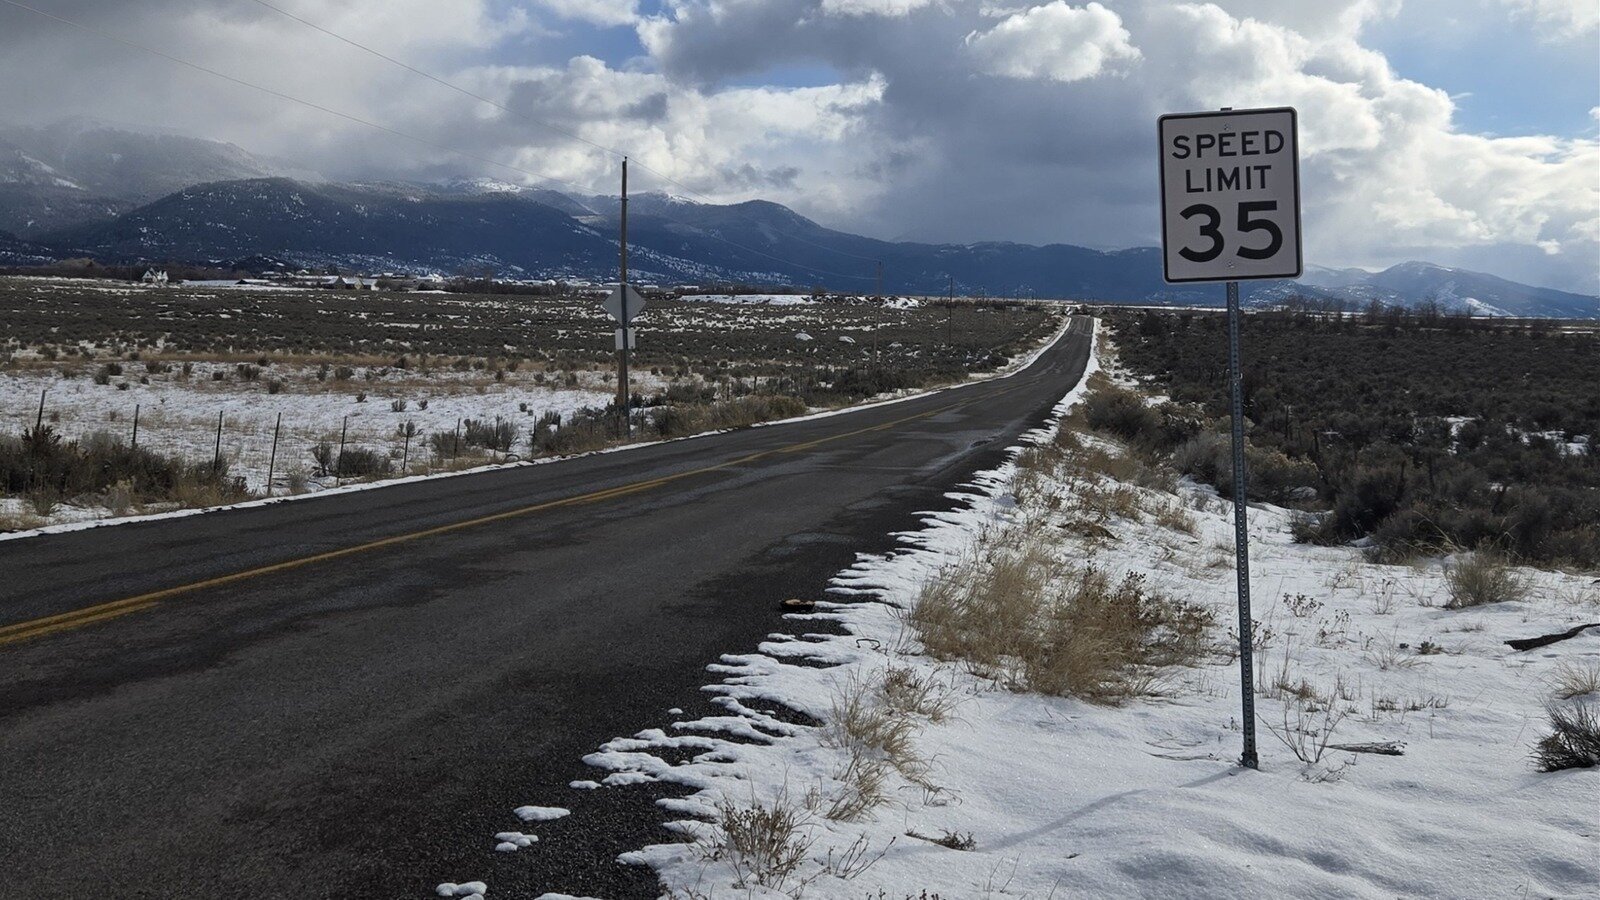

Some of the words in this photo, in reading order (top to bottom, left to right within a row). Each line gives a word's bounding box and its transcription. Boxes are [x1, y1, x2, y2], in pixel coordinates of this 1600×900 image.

[1172, 130, 1285, 159] SPEED
[1185, 165, 1272, 193] LIMIT
[1178, 200, 1283, 262] 35
